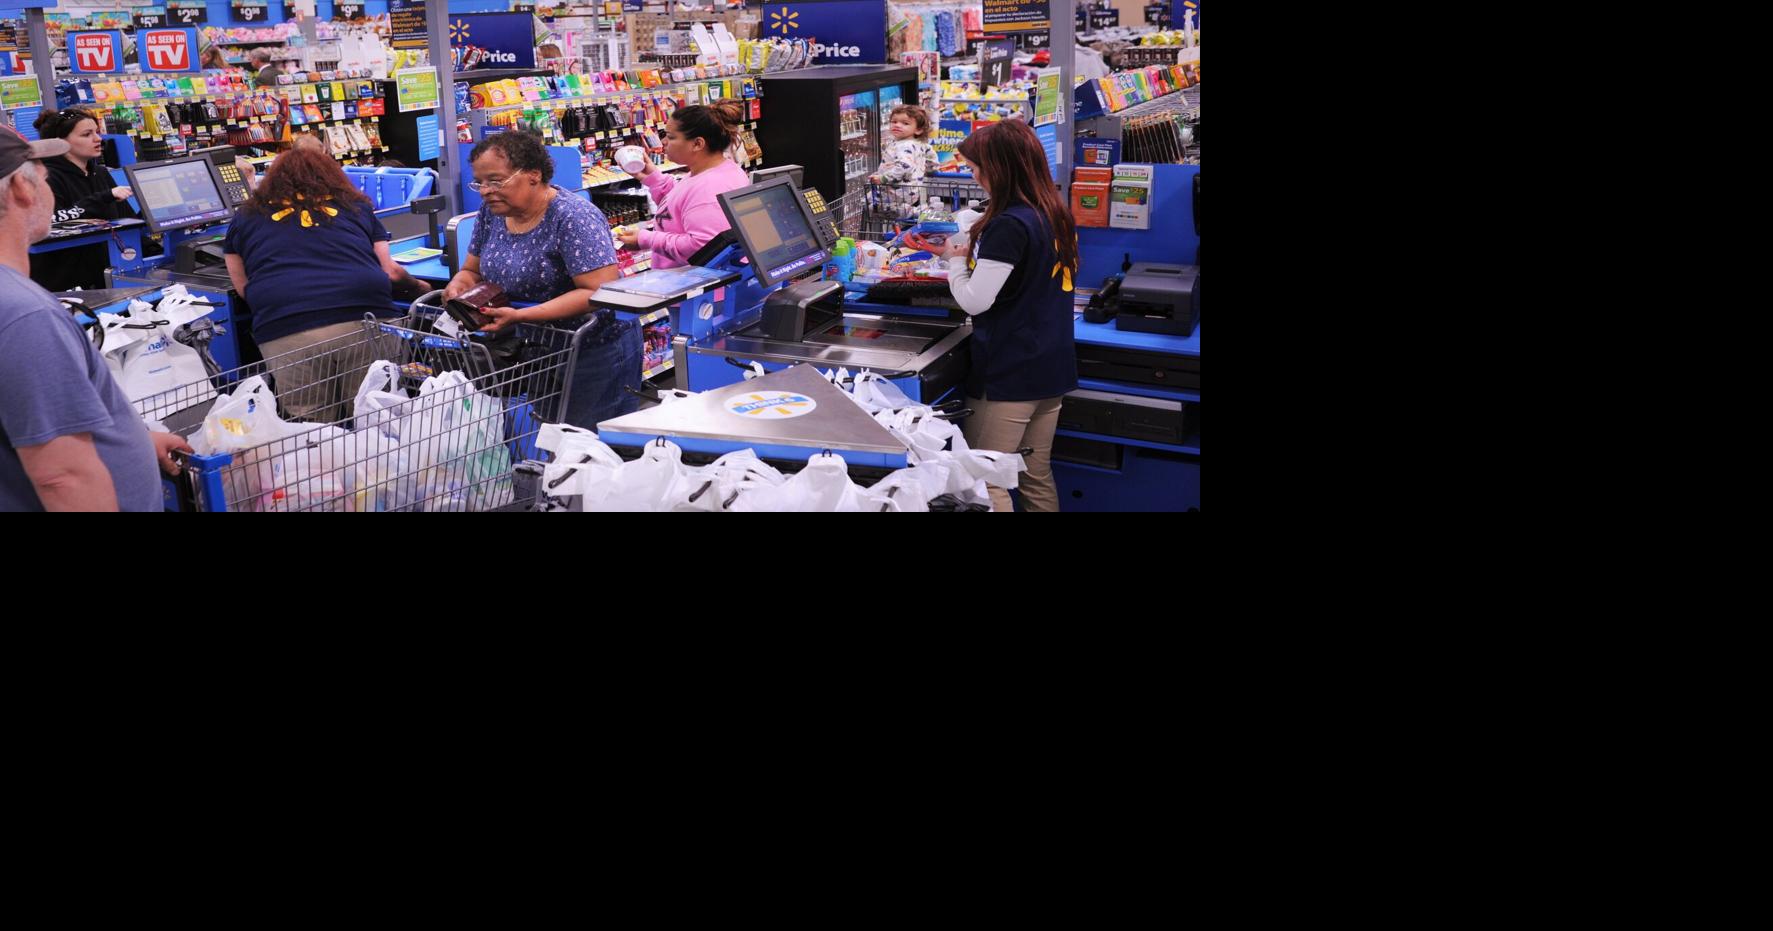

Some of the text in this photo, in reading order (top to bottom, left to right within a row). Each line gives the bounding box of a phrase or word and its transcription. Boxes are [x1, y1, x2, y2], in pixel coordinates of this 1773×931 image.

[76, 38, 111, 46] AS SEEN ON
[147, 34, 185, 44] AS SEEN ON
[148, 44, 184, 65] TV
[481, 50, 516, 62] Price
[813, 42, 860, 57] Price
[77, 47, 110, 67] TV
